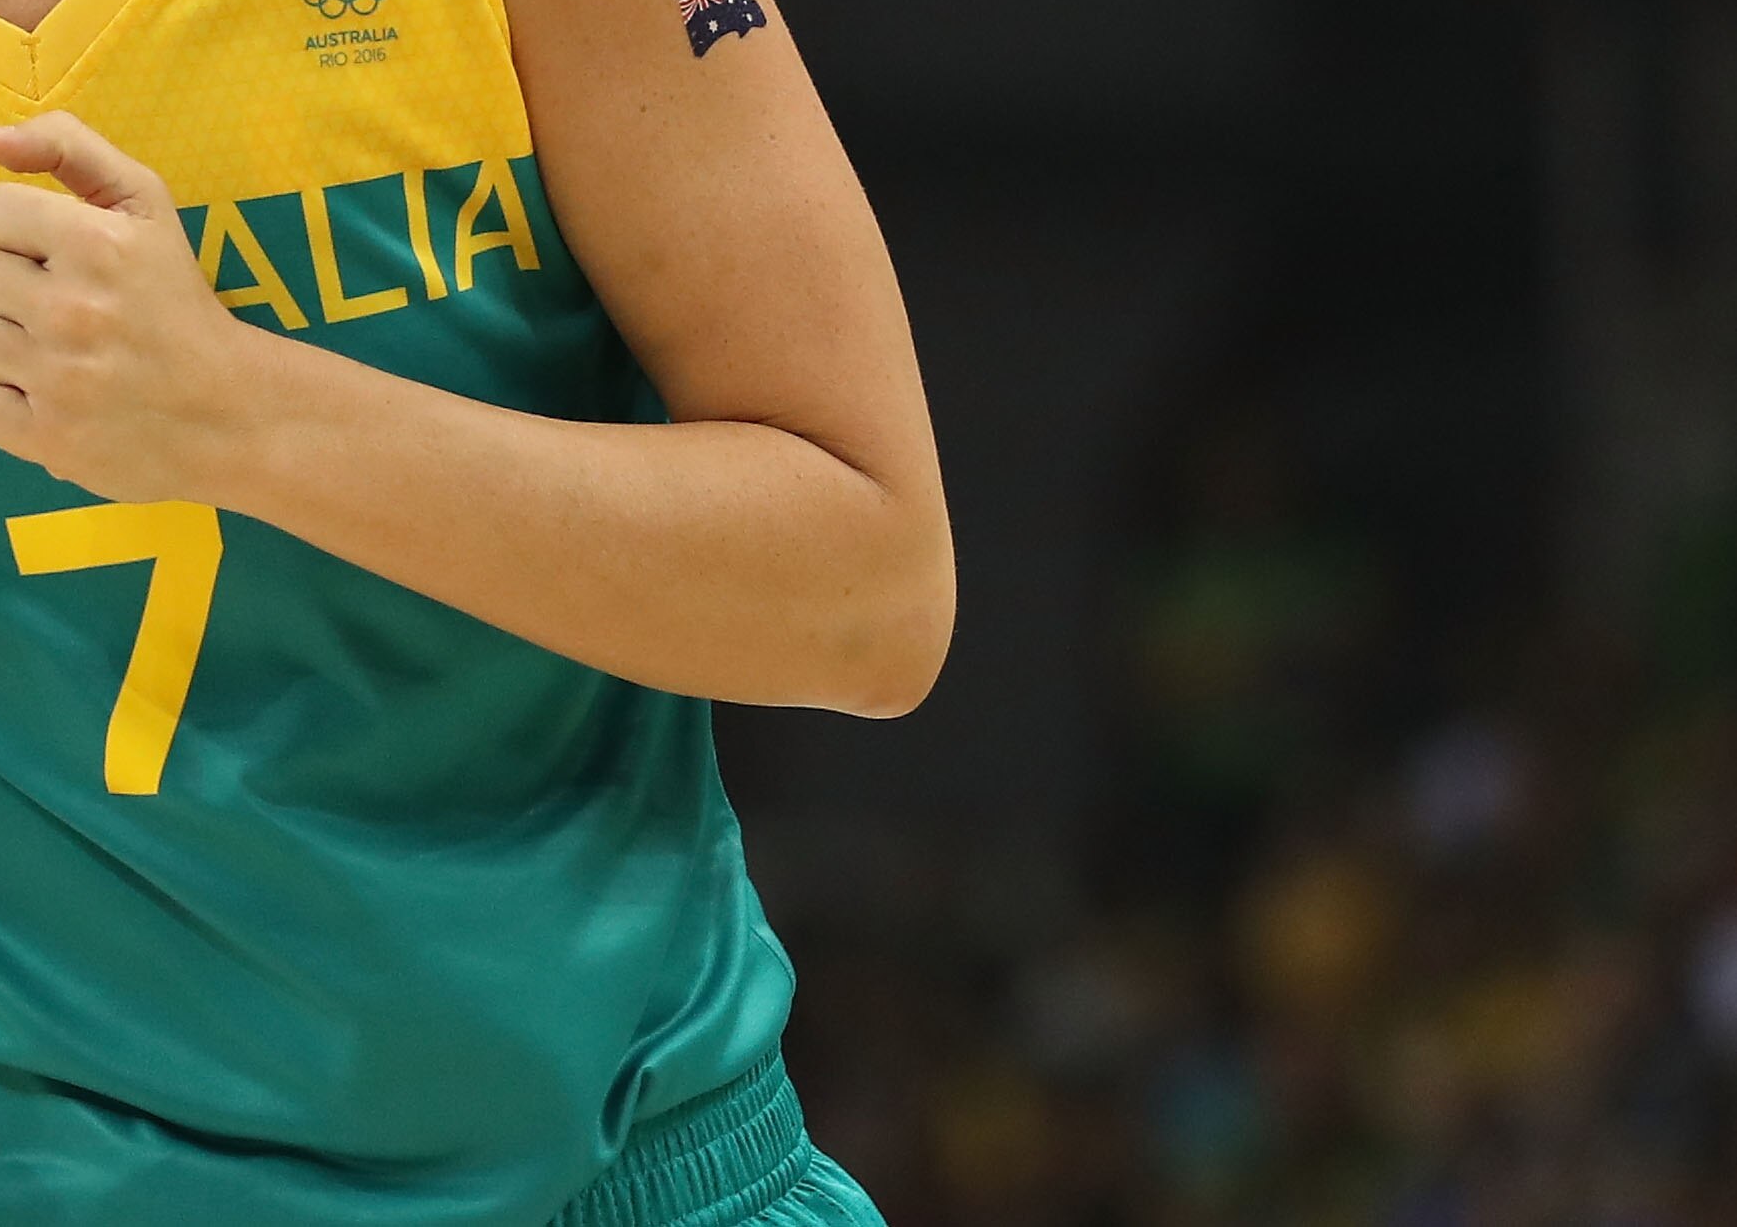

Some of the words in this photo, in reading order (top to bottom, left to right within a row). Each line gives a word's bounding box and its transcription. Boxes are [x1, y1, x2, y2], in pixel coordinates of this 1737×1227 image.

[306, 27, 399, 50] AUSTRALIA
[319, 52, 348, 68] RIO
[353, 47, 387, 64] 2016
[5, 500, 225, 795] 7
